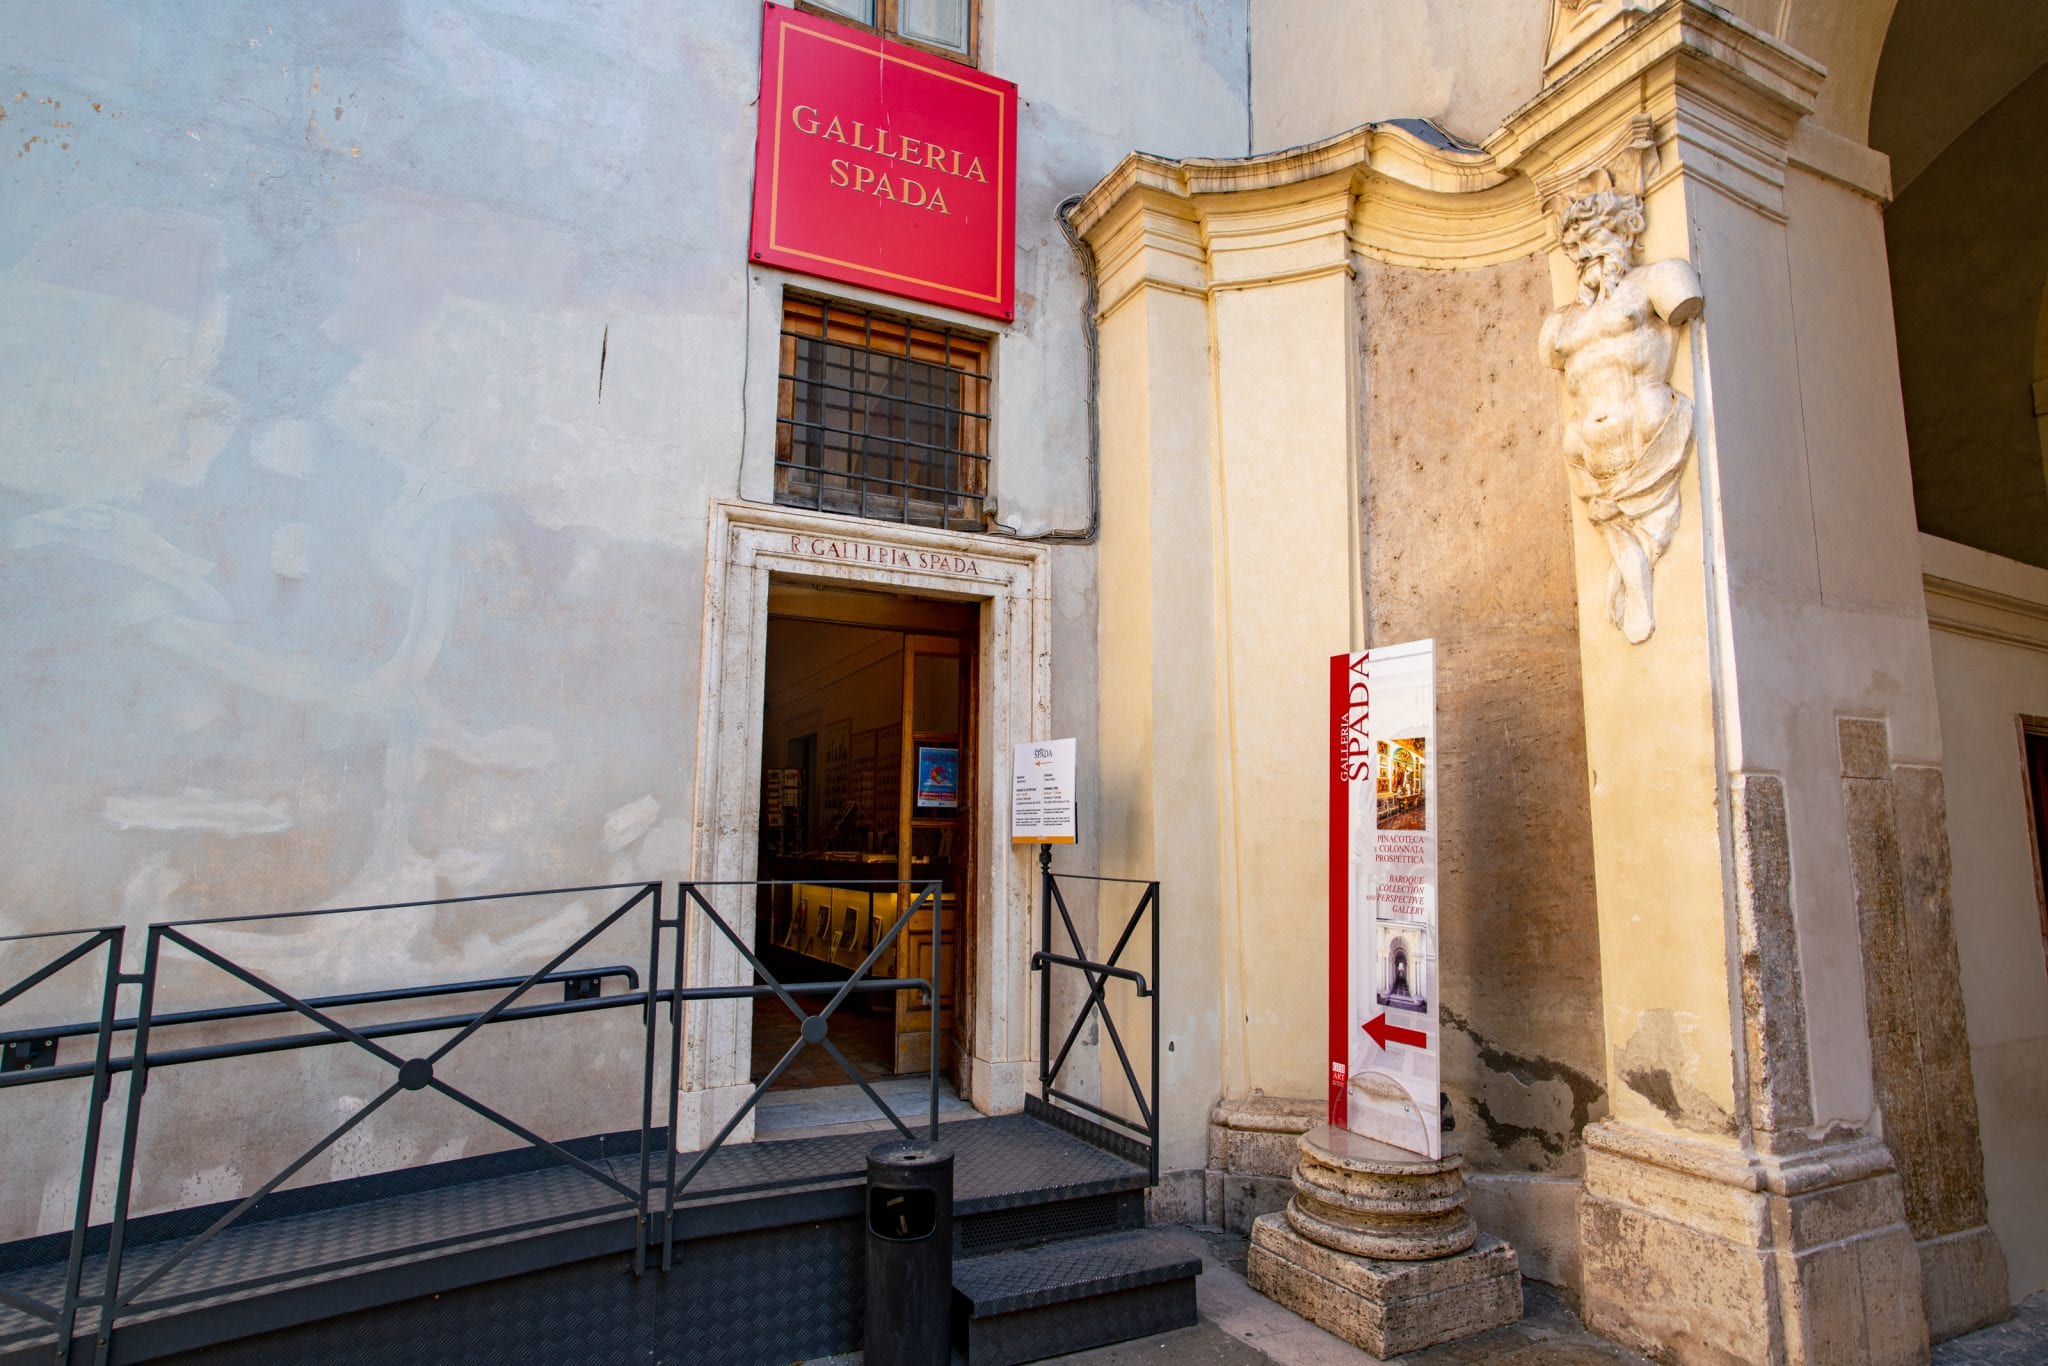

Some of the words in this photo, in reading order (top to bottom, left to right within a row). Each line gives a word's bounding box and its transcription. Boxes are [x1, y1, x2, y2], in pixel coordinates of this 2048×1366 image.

[791, 104, 989, 184] GALLERIA
[829, 158, 951, 215] SPADA
[919, 552, 980, 576] SPADA
[1348, 651, 1370, 781] SPADA
[1340, 712, 1349, 782] GALLERIA
[1377, 834, 1425, 844] PINACOTECA
[1379, 844, 1425, 854] COLONNATA
[1375, 854, 1425, 864] PROSPETTICA
[1389, 874, 1425, 886] BAROQUE
[1378, 883, 1425, 895] COLLECTION
[1376, 893, 1425, 905] PERSPECTIVE
[1392, 904, 1425, 915] GALLERY
